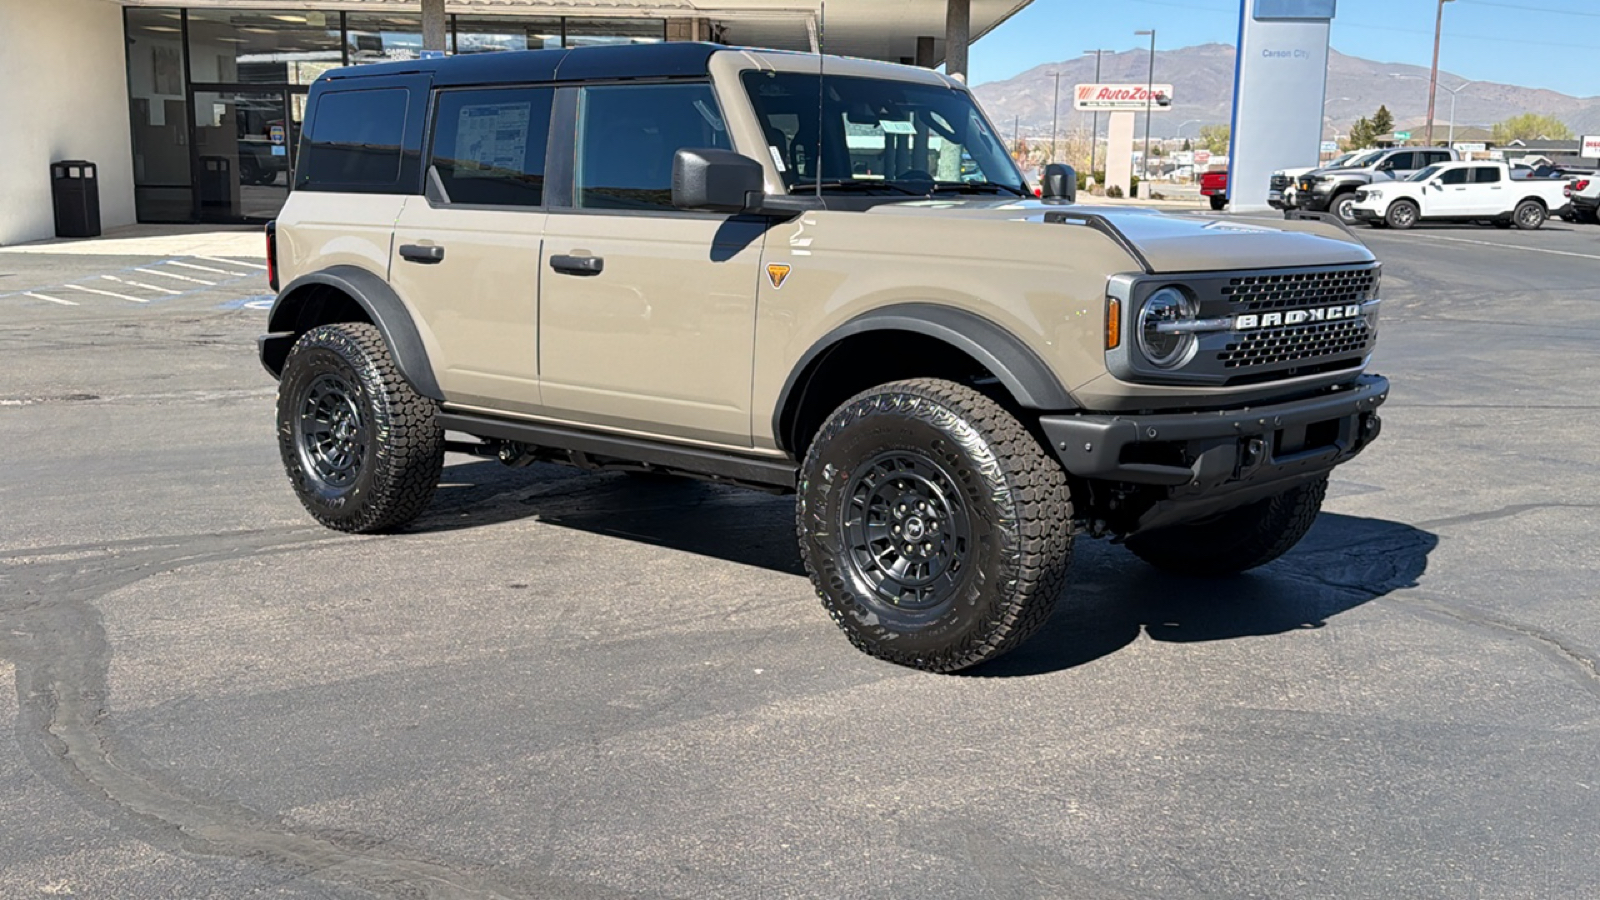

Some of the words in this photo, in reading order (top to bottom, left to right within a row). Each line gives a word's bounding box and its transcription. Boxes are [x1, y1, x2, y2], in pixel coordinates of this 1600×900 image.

[1262, 49, 1291, 58] Carson
[1294, 49, 1310, 60] City
[1236, 304, 1360, 330] BRONCO
